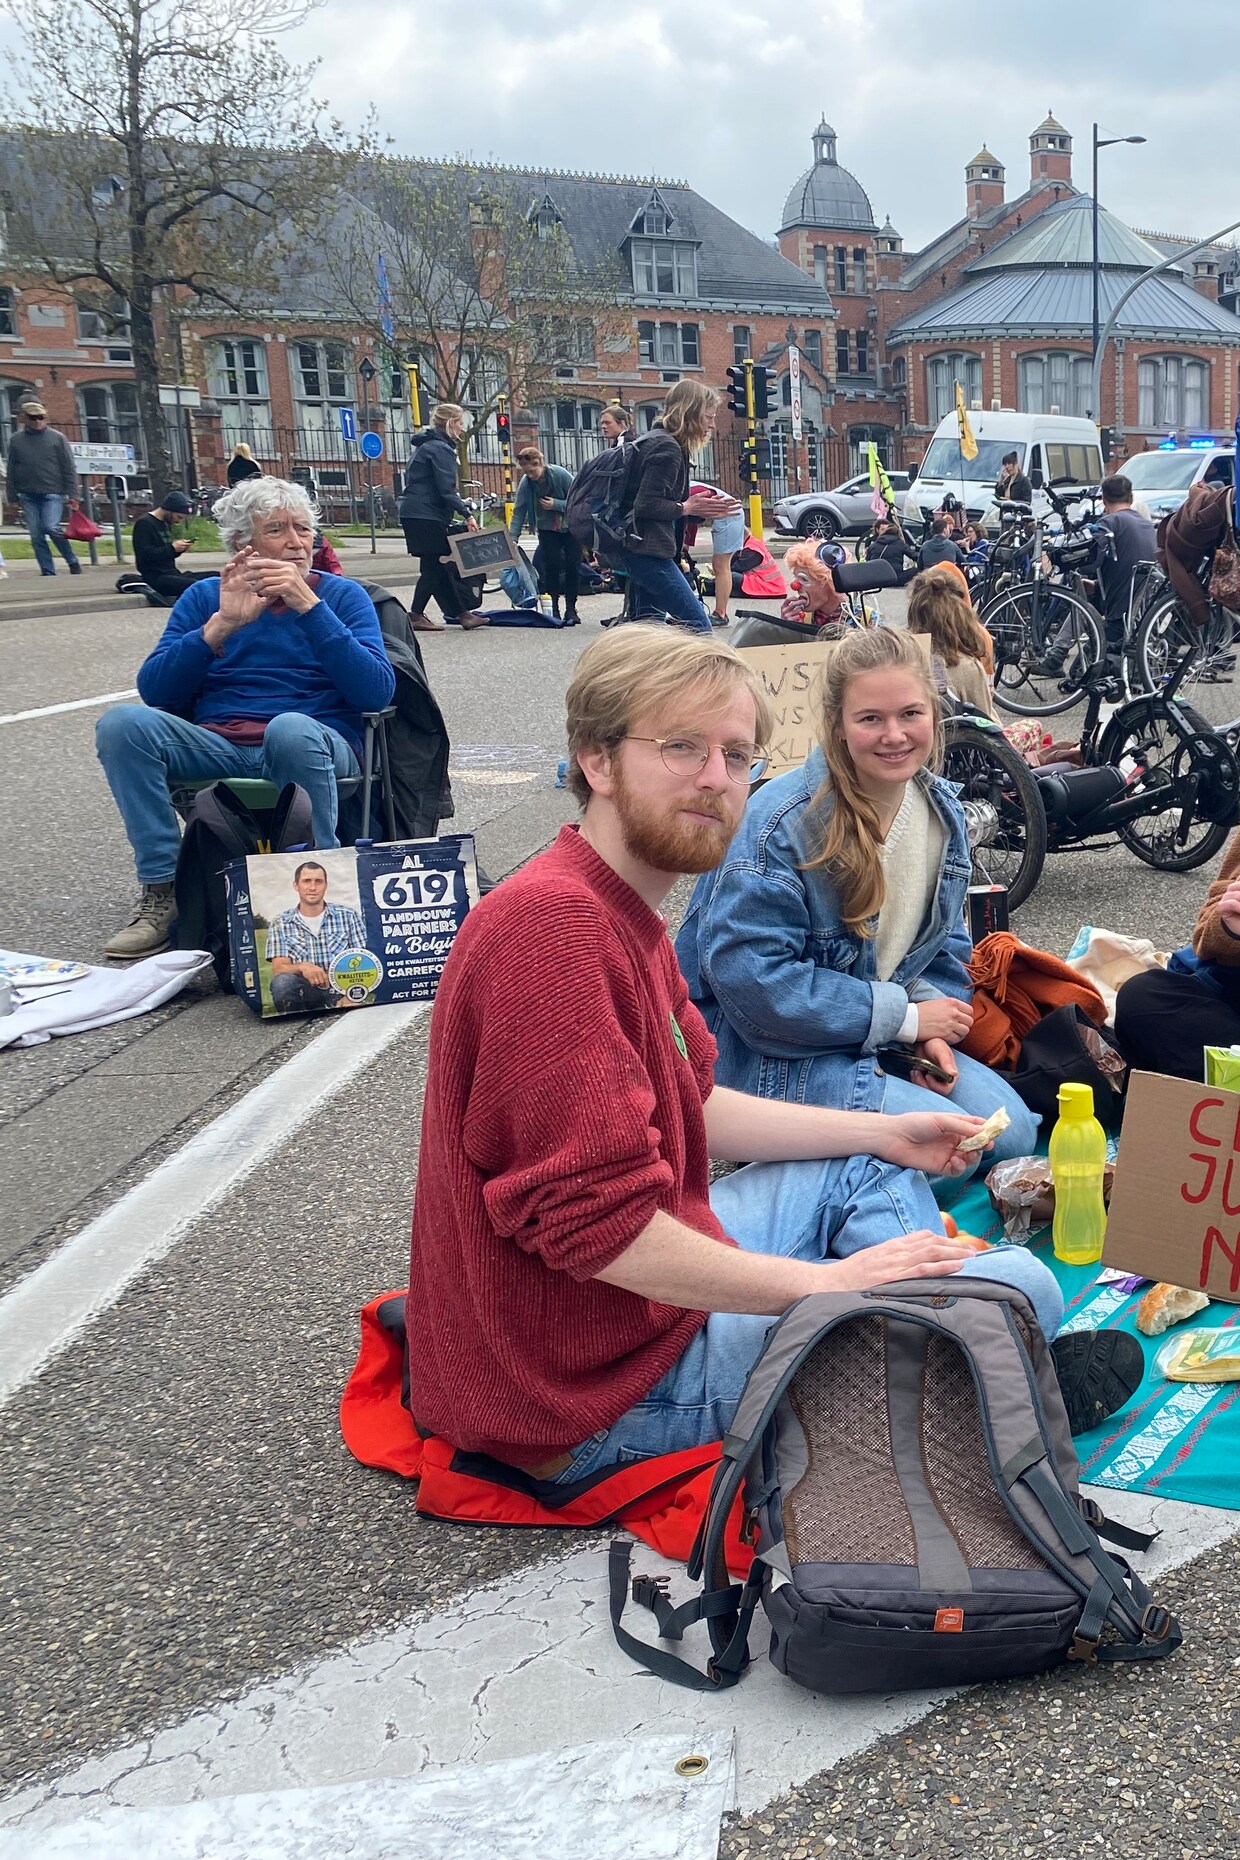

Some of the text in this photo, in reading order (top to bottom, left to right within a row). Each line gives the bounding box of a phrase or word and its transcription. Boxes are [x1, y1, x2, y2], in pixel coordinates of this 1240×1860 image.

[402, 855, 424, 869] AL
[383, 873, 448, 907] 619
[381, 908, 456, 924] LANDBOUW-
[382, 920, 457, 938] PARTNERS
[385, 942, 402, 955] in
[387, 964, 445, 978] CARREFO
[412, 981, 429, 989] DAT
[392, 991, 410, 999] ACT
[411, 989, 429, 997] FOR
